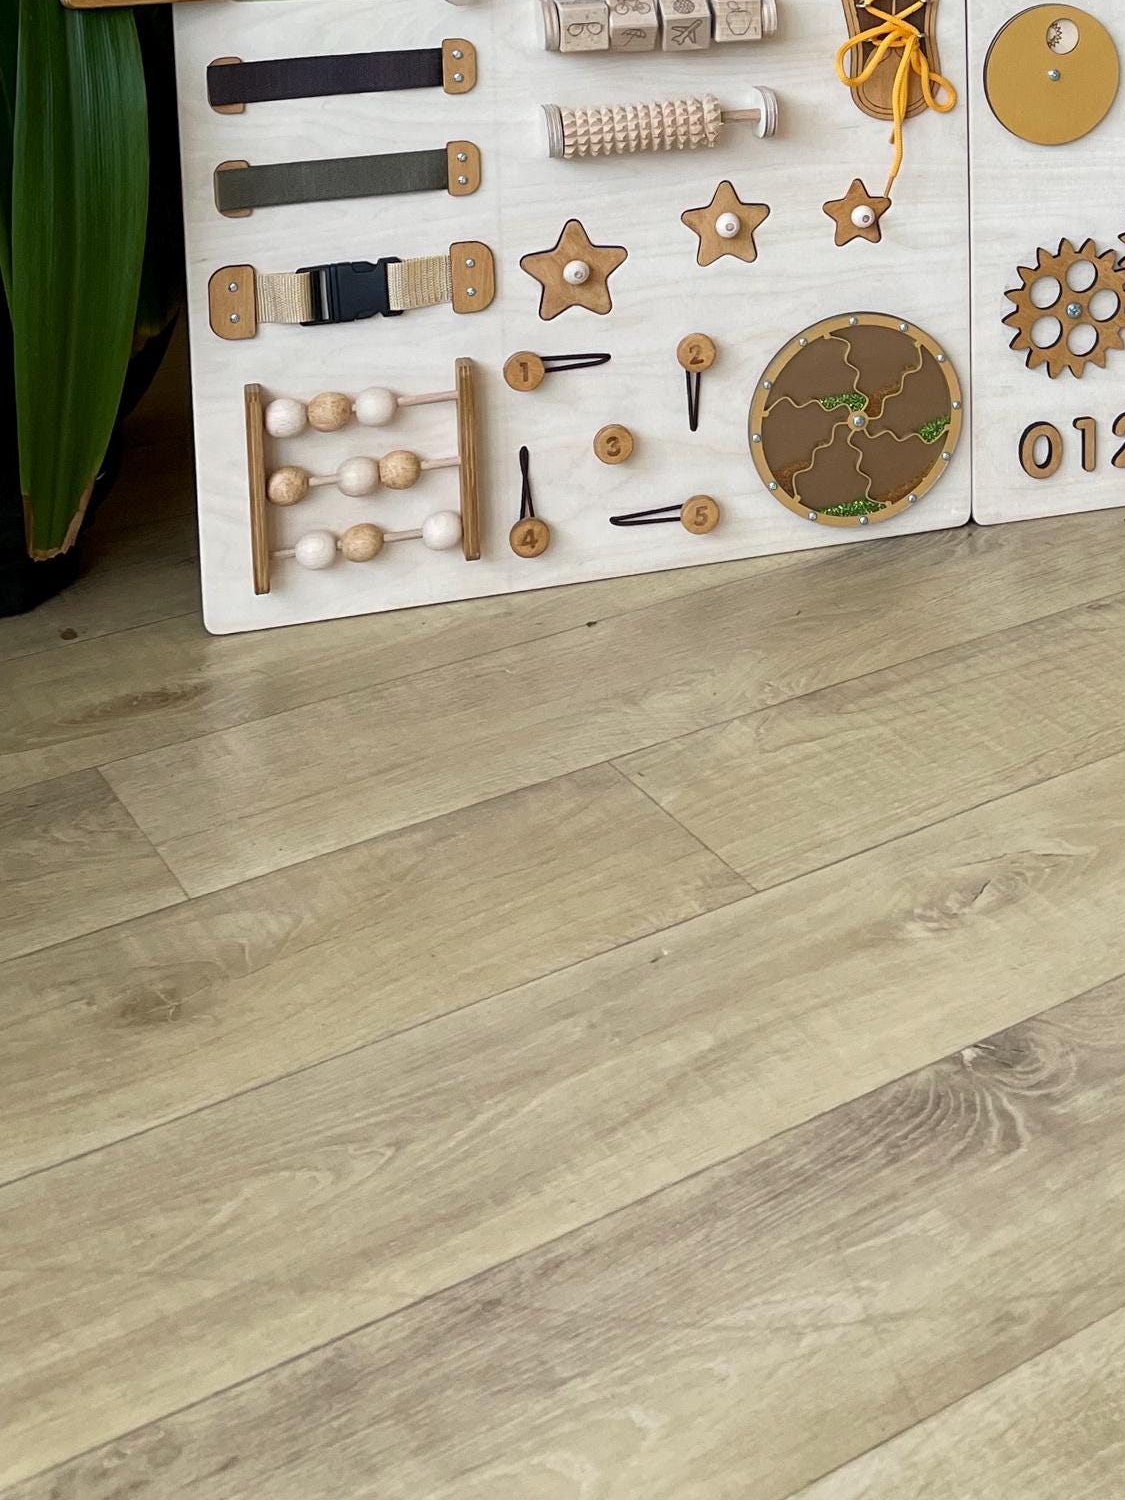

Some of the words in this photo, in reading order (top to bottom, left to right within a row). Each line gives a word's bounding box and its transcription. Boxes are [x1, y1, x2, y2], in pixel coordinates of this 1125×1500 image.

[688, 344, 705, 365] 2
[518, 361, 530, 383] 1
[605, 436, 621, 457] 3
[1019, 420, 1064, 480] 0
[1072, 416, 1097, 473] 1
[693, 505, 709, 527] 5
[519, 528, 539, 549] 4
